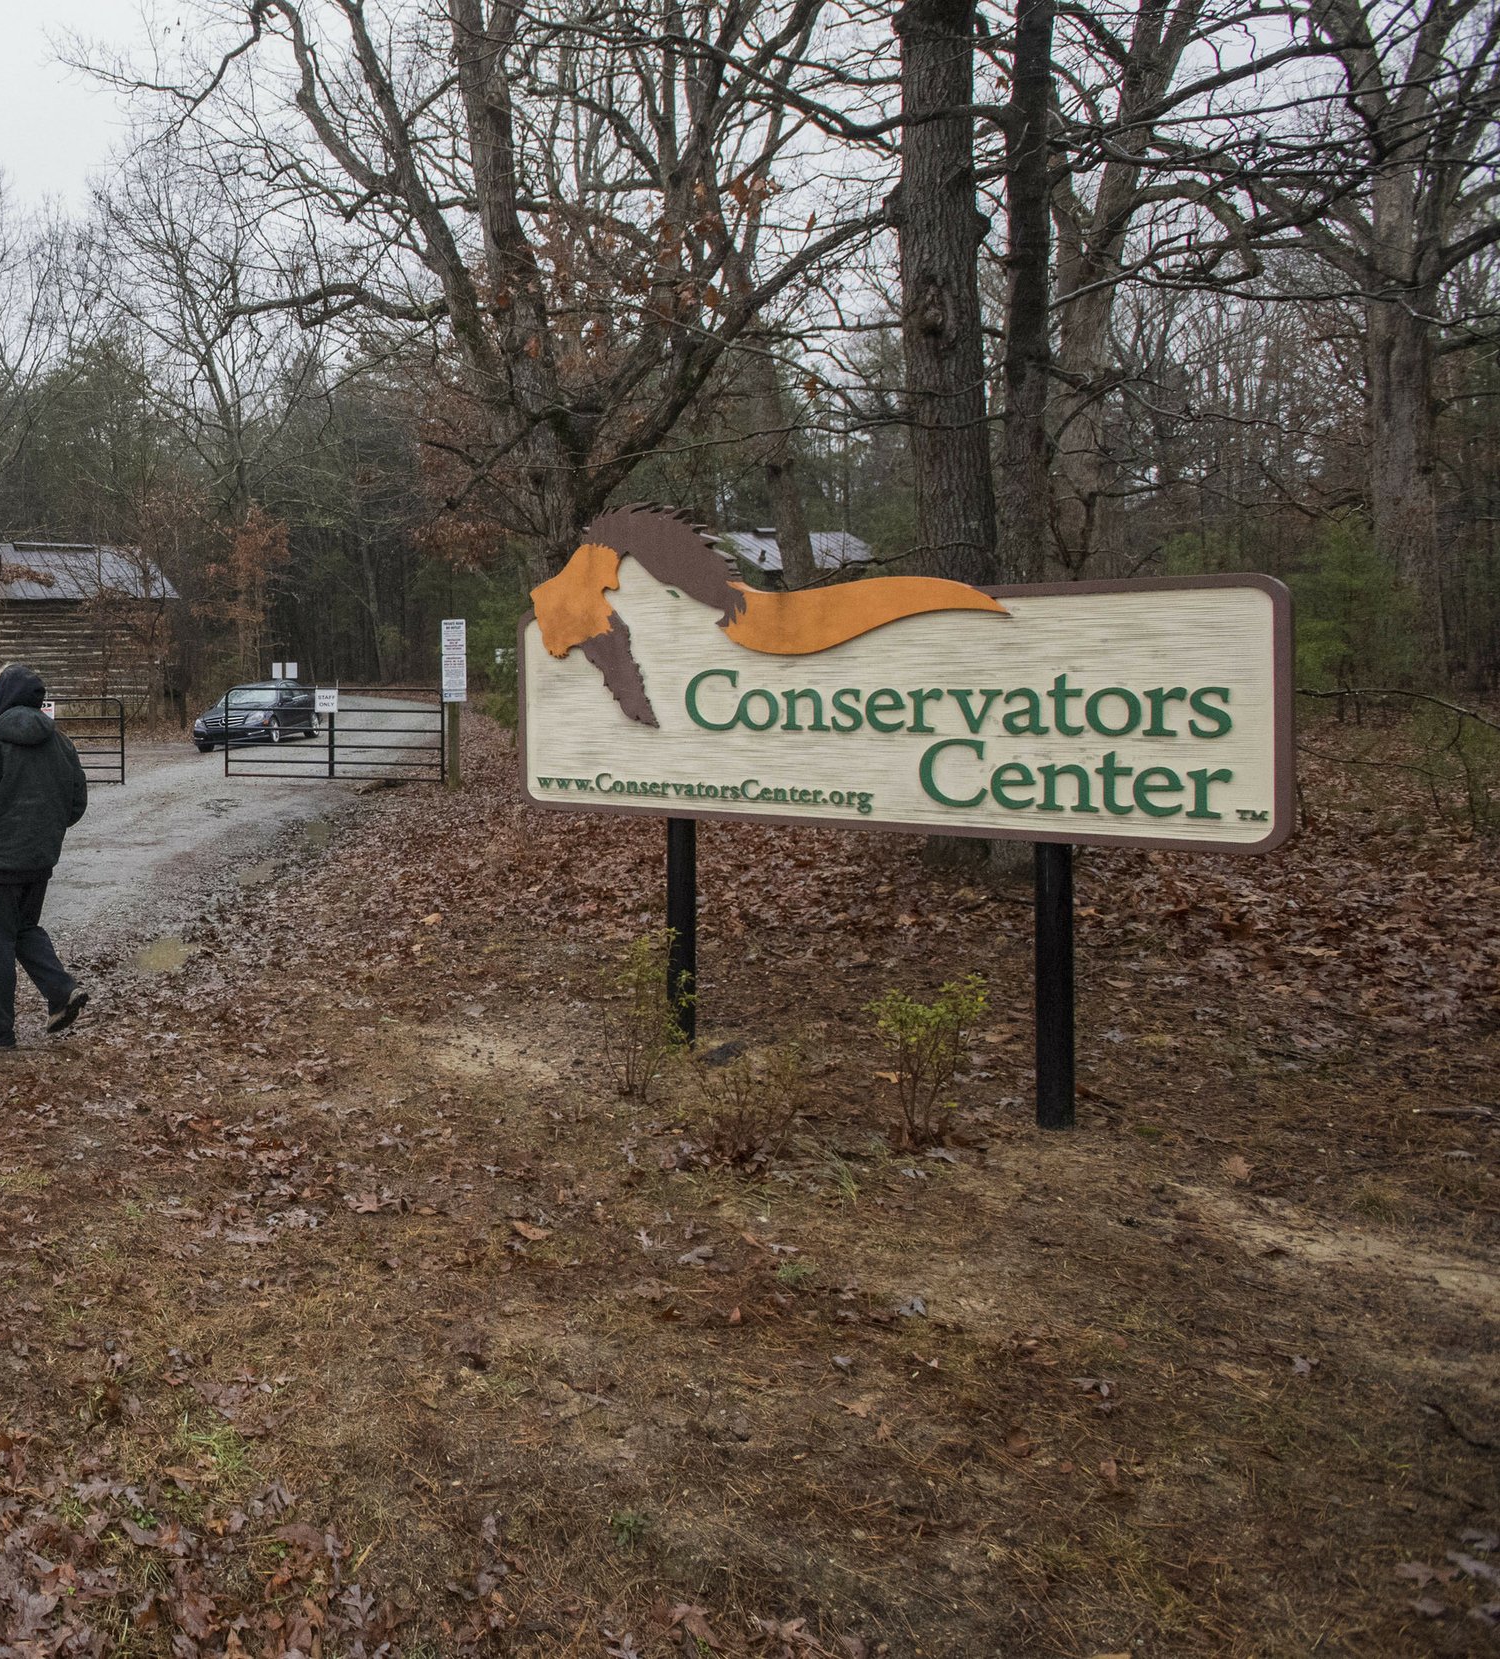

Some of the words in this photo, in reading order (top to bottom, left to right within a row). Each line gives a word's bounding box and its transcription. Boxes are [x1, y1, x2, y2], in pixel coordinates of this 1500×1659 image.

[685, 668, 1232, 739] Conservators
[536, 772, 875, 814] www.ConservatorsCenter.org
[919, 738, 1233, 818] Center
[1235, 808, 1269, 822] TM
